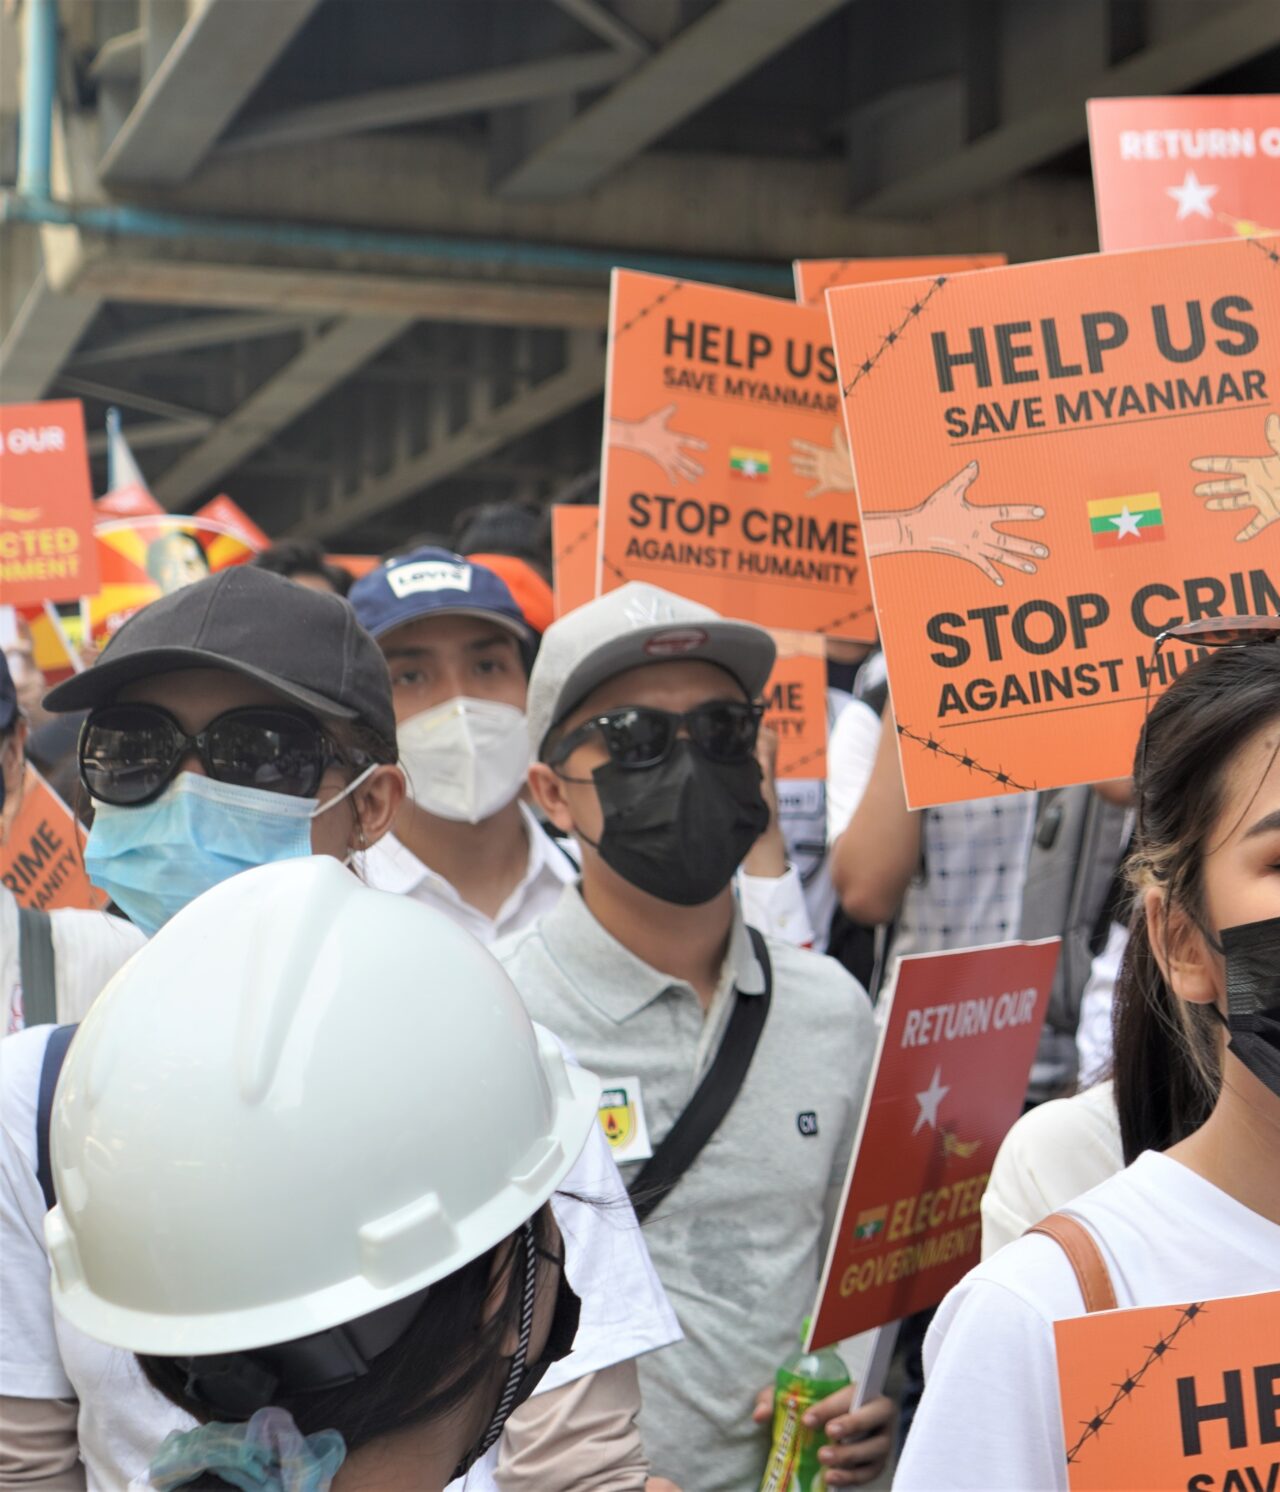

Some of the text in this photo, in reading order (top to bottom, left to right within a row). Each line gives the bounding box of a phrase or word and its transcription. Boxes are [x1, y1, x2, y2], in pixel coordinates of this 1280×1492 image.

[1119, 129, 1257, 160] RETURN
[664, 316, 838, 385] HELP US
[930, 295, 1260, 393] HELP US
[664, 367, 838, 413] SAVE MYANMAR
[943, 369, 1269, 439] SAVE MYANMAR
[7, 426, 66, 455] OUR
[0, 526, 79, 558] CTED
[628, 492, 858, 557] STOP CRIME
[625, 537, 858, 586] AGAINST HUMANITY
[925, 592, 1111, 669] STOP
[936, 659, 1125, 718] AGAINST
[3, 820, 62, 895] RIME
[901, 987, 1038, 1048] RETURN OUR
[841, 1222, 980, 1297] GOVERNMENT
